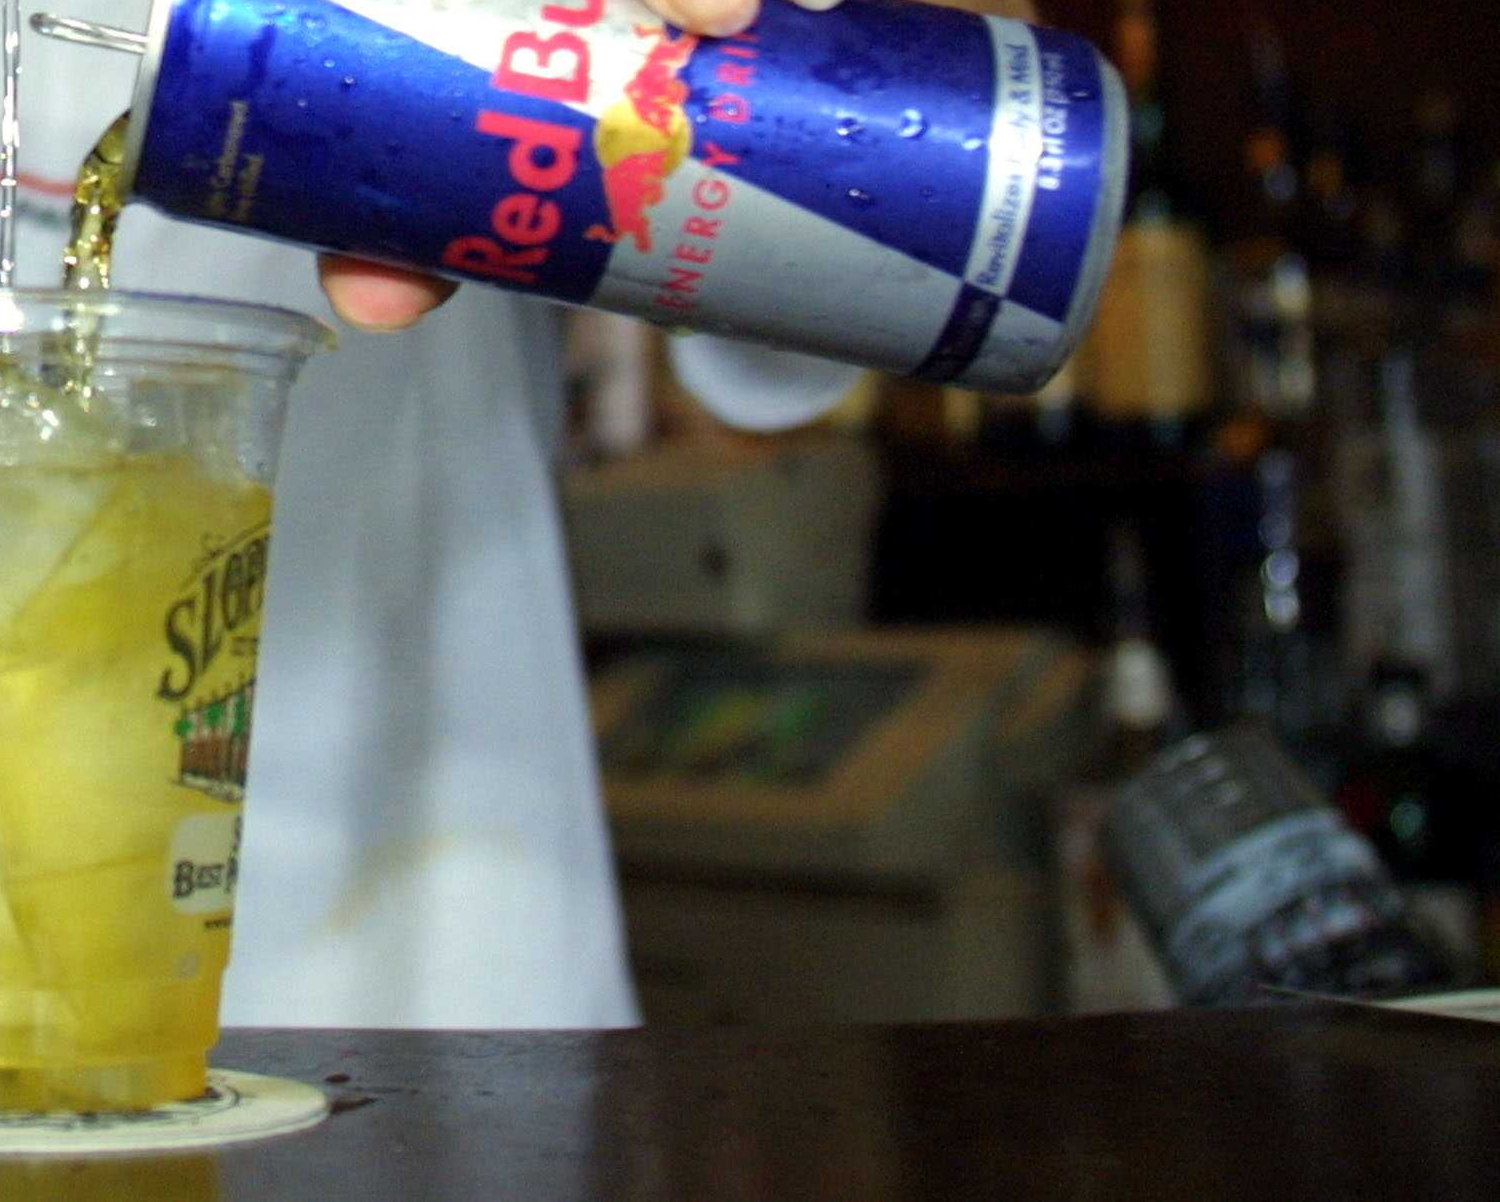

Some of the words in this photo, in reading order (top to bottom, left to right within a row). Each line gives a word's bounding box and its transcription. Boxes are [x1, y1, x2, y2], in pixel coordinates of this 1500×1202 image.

[443, 109, 583, 284] Red
[655, 141, 741, 311] ENERGY
[708, 31, 761, 125] DRI
